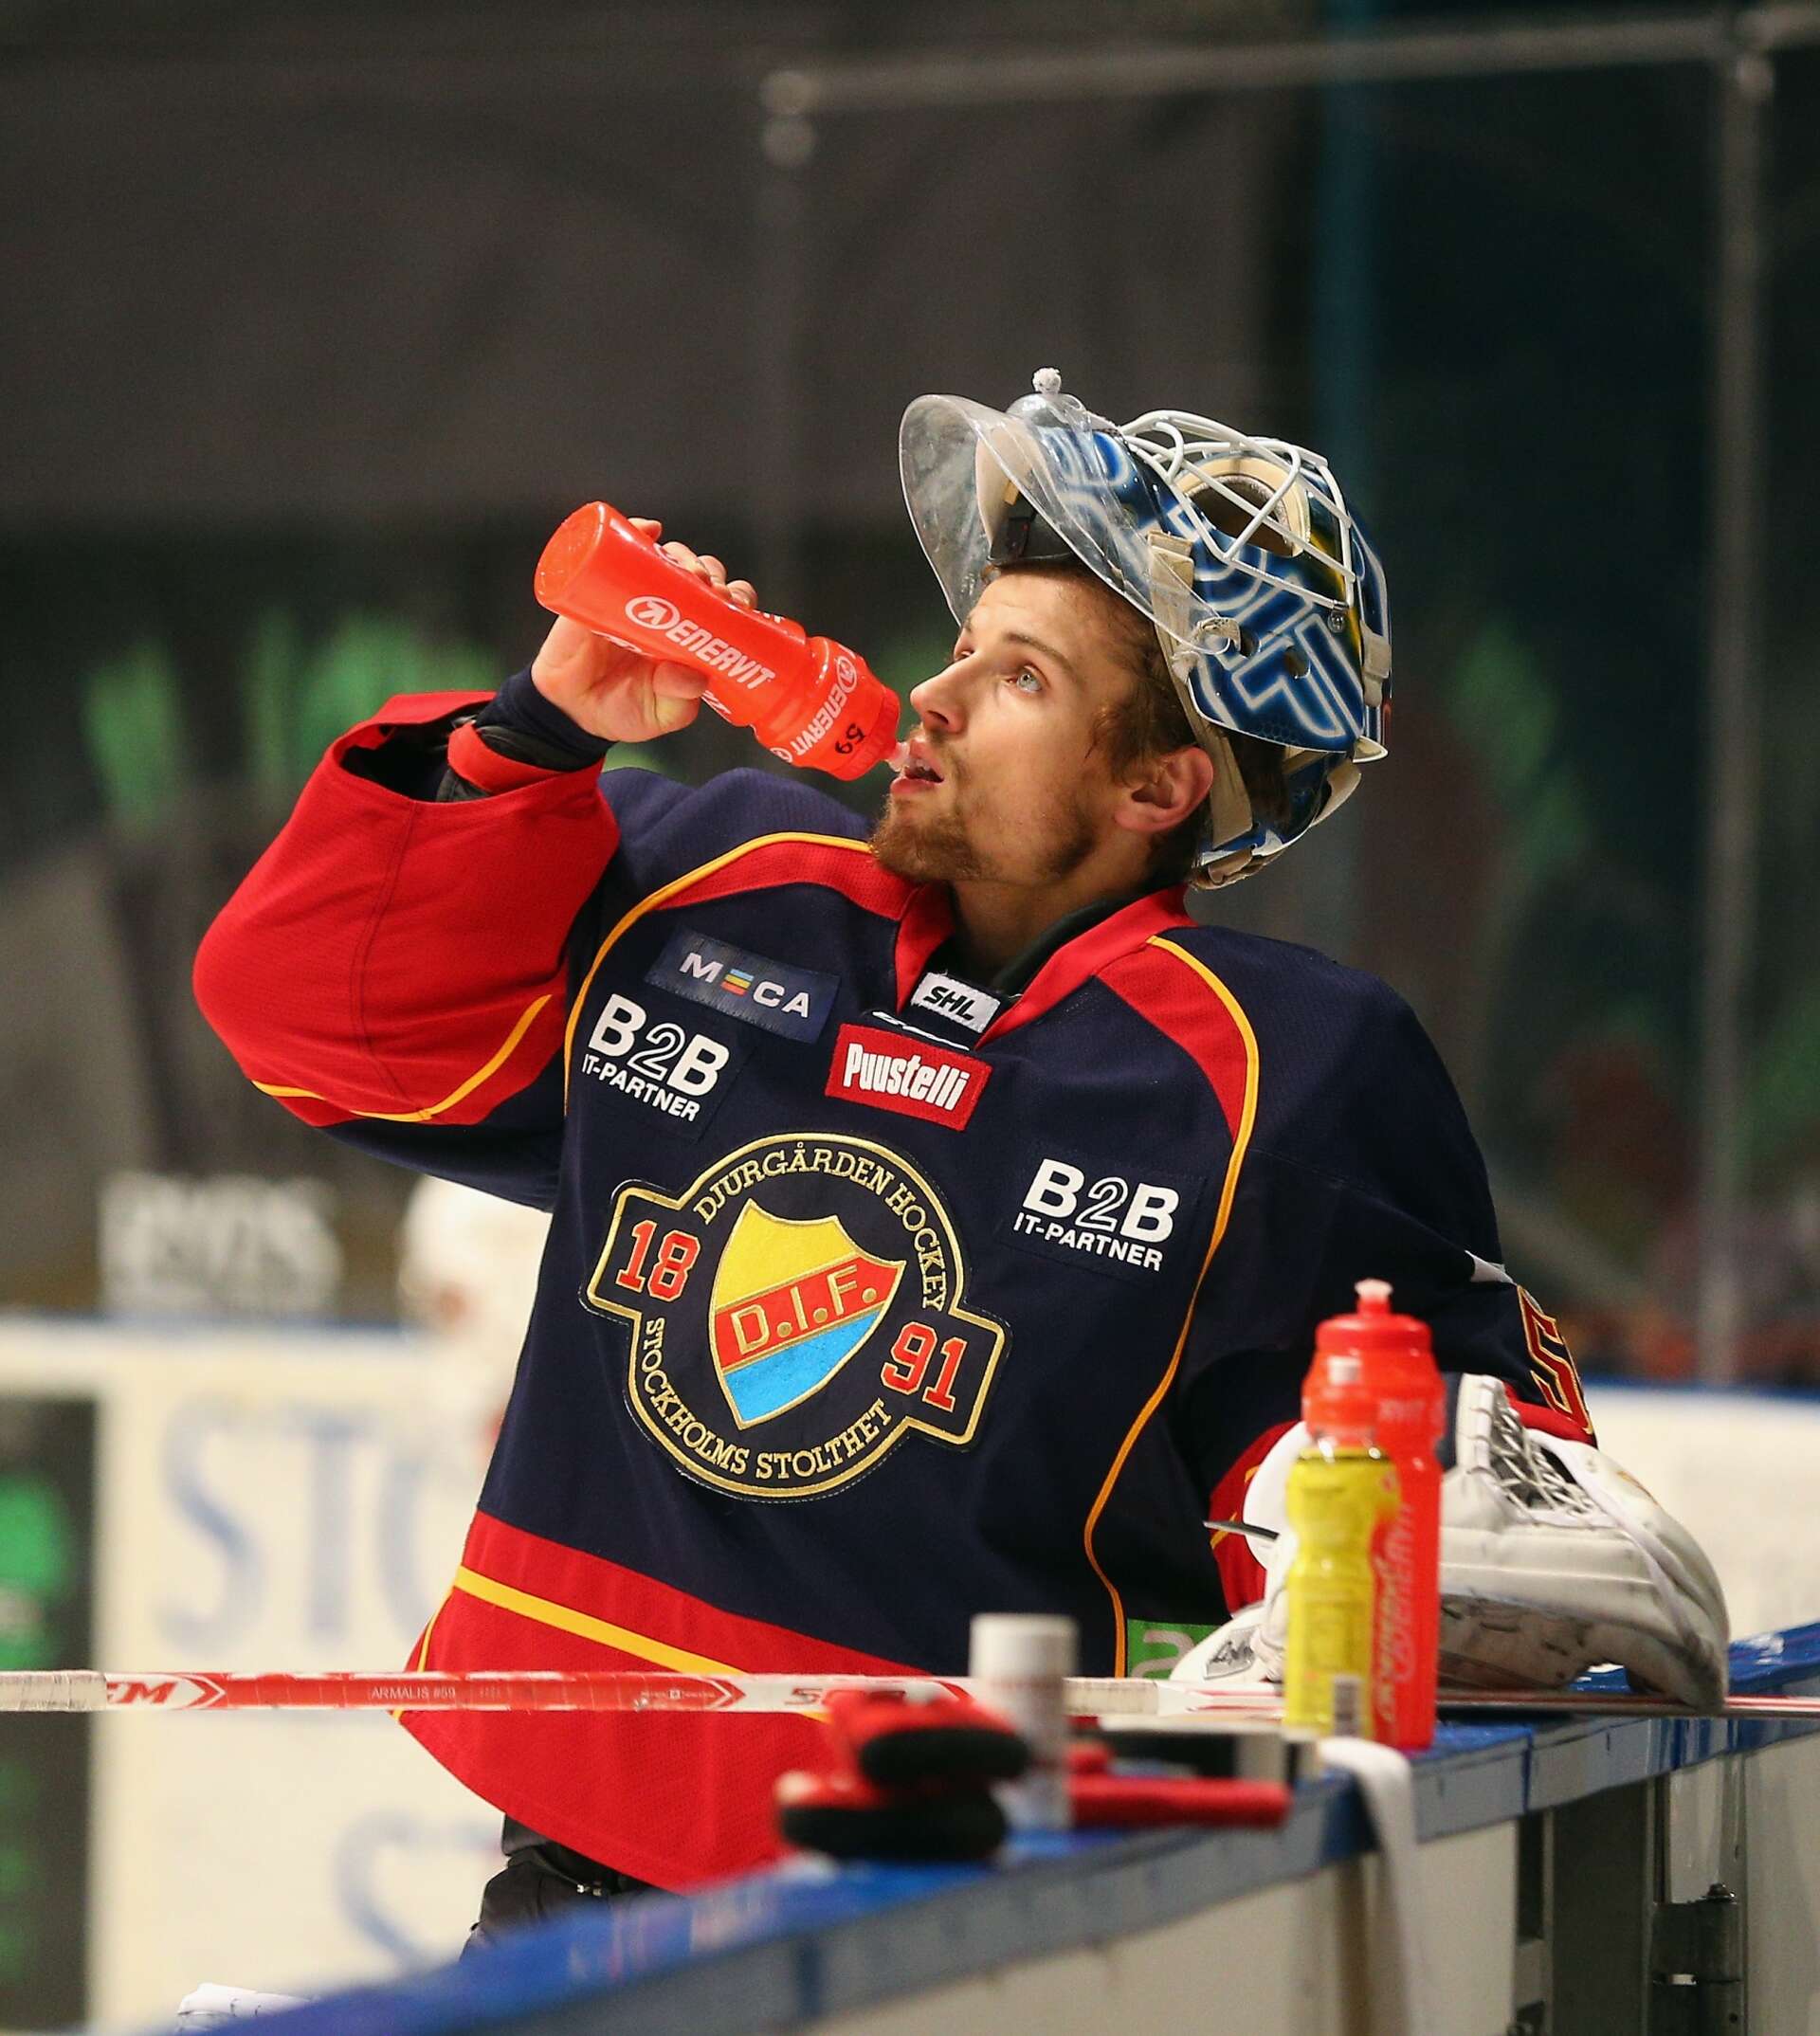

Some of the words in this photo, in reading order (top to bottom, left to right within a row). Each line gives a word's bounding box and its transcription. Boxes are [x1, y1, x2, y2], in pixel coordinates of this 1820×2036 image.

[665, 619, 775, 690] ENERVIT
[791, 683, 847, 755] ENERVIT
[835, 722, 865, 754] 59
[923, 984, 974, 1022] SHL
[588, 993, 730, 1097] B2B
[844, 1043, 970, 1111] Puustelli
[582, 1053, 701, 1122] IT-PARTNER
[693, 1141, 894, 1226] DJURGÅRDEN
[884, 1182, 946, 1312] HOCKEY
[1022, 1158, 1179, 1243] B2B
[615, 1218, 701, 1302] 18
[1012, 1211, 1163, 1272] IT-PARTNER
[730, 1264, 877, 1355] D.I.F.
[641, 1316, 750, 1475] STOCKHOLMS
[755, 1398, 892, 1480] STOLTHET
[880, 1321, 968, 1412] 91
[371, 1685, 429, 1700] ARMALIS
